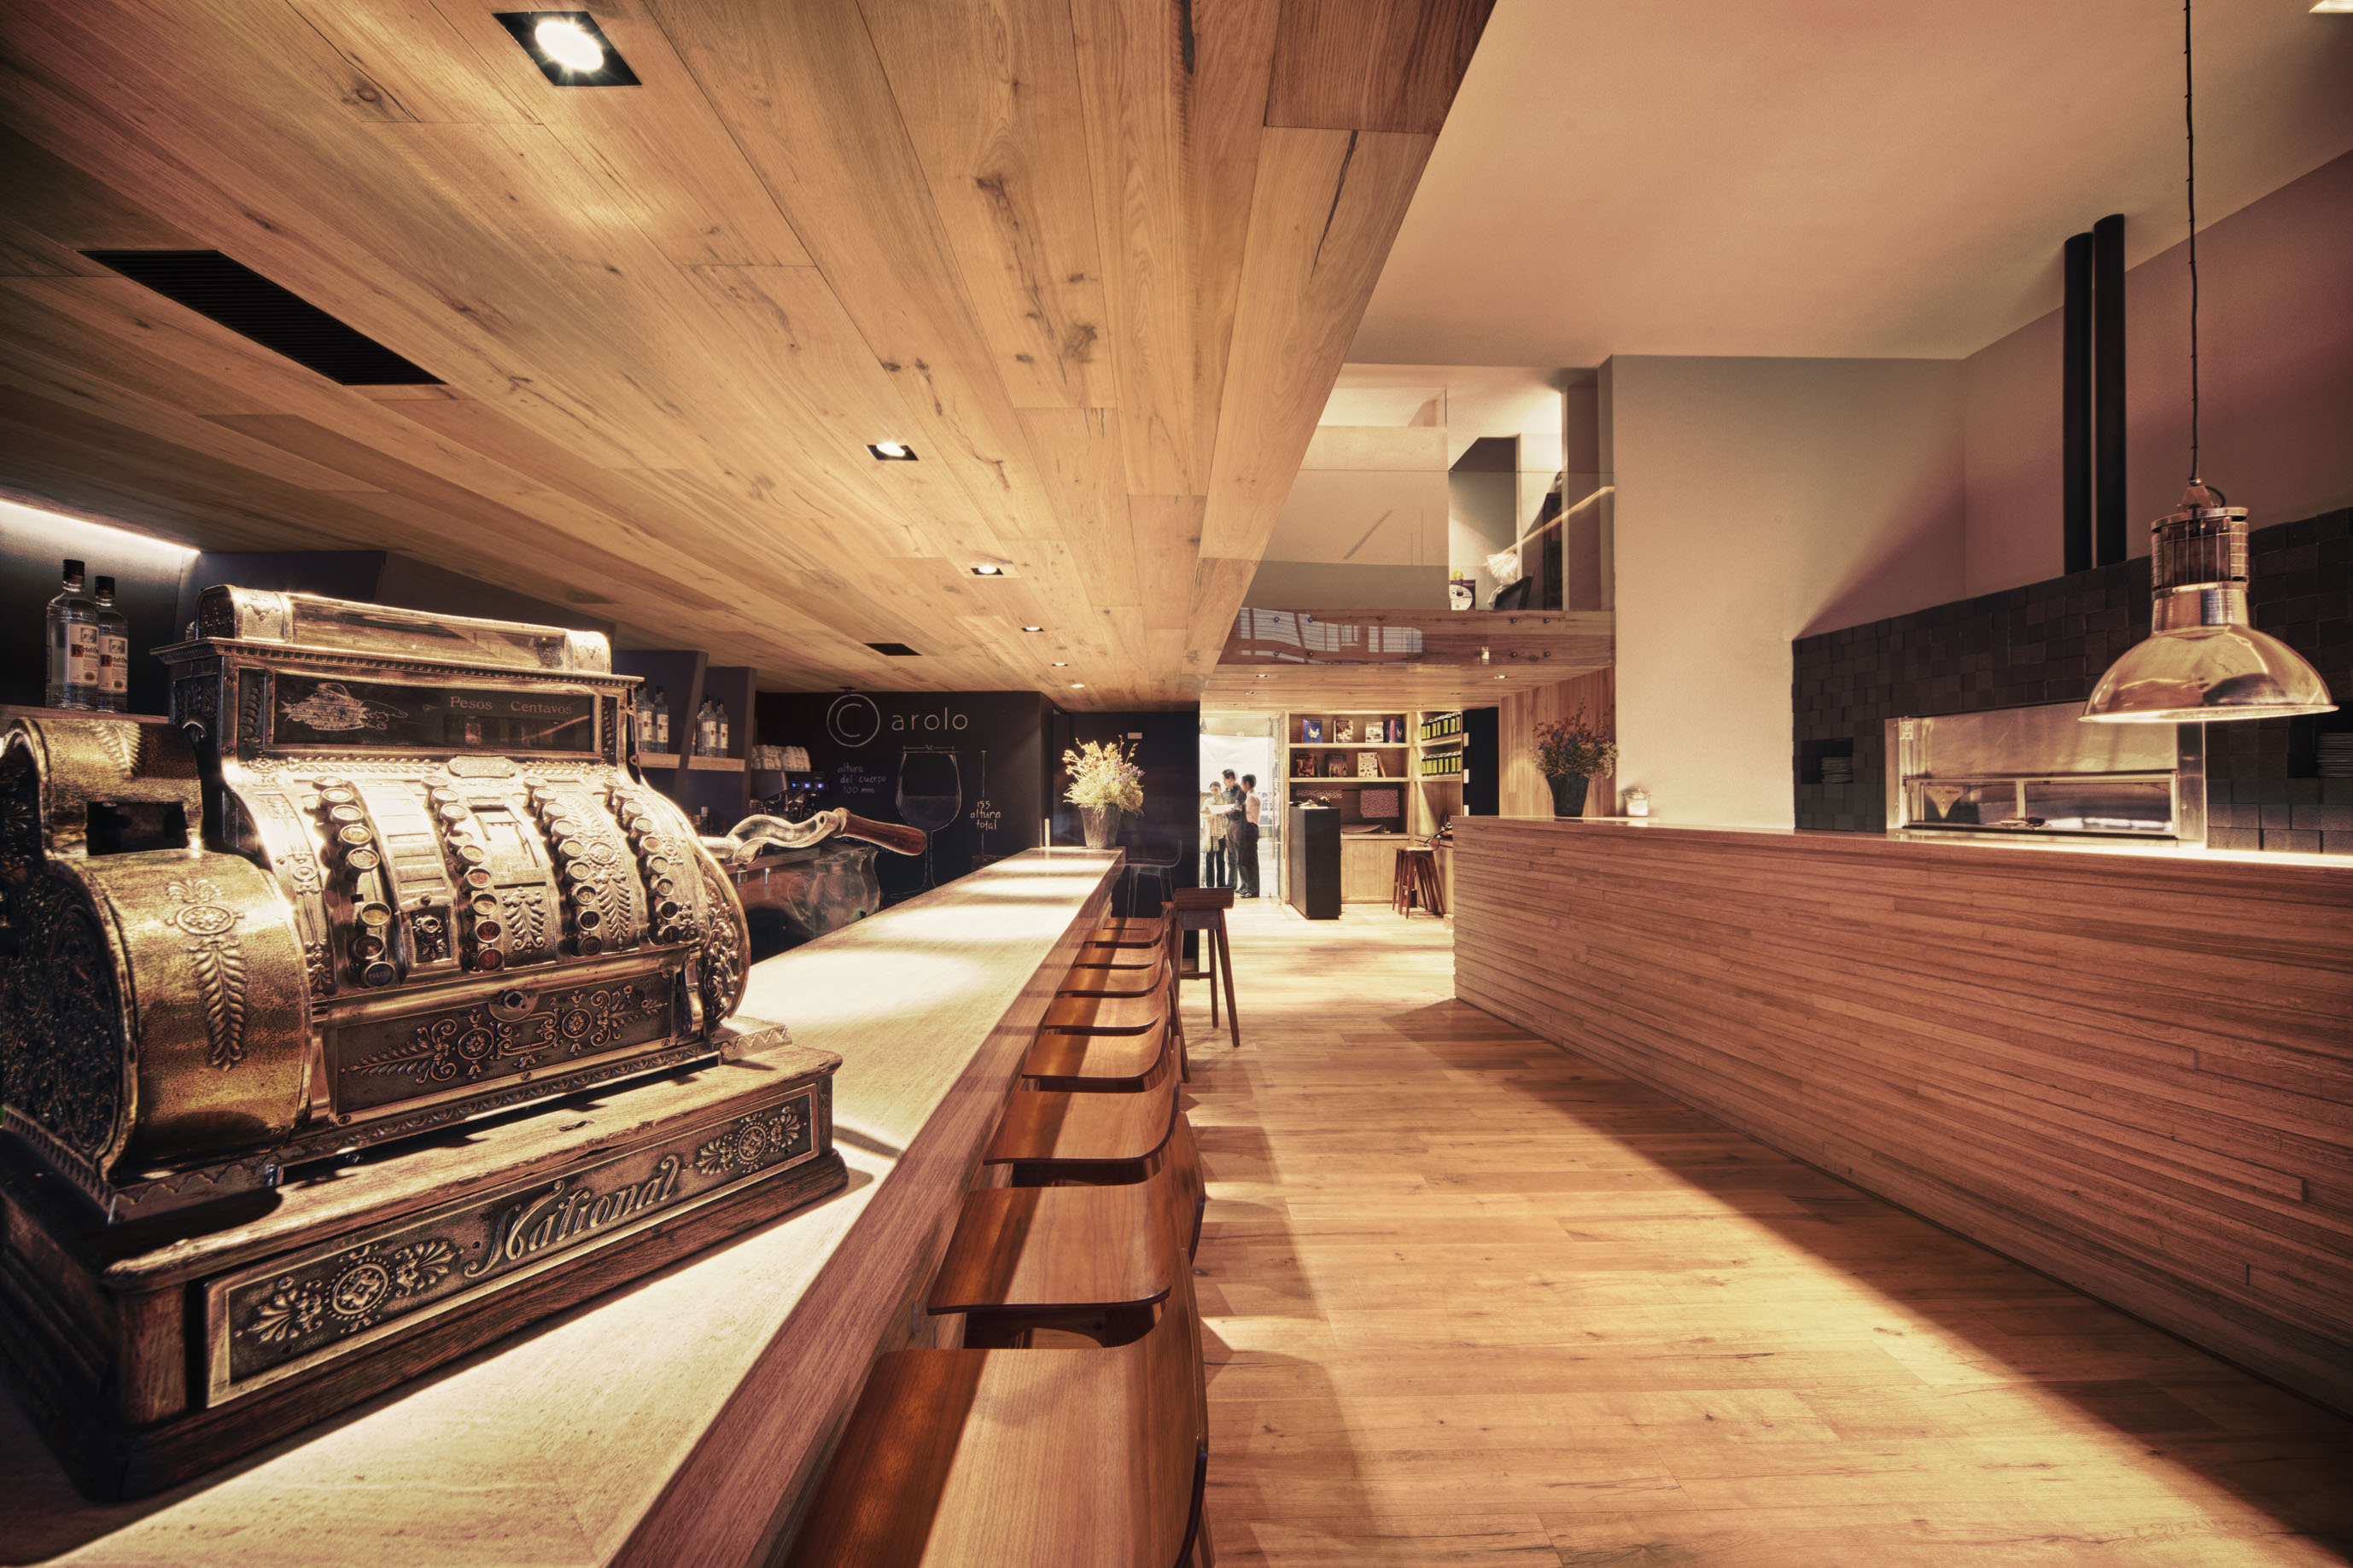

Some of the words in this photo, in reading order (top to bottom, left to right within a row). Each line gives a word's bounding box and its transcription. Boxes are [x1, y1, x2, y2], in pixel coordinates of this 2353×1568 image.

[450, 696, 493, 710] Pesos
[510, 701, 573, 714] Centavos
[837, 761, 864, 773] altura
[840, 774, 853, 784] del
[858, 776, 888, 785] cuerpo
[977, 800, 991, 810] 155
[970, 807, 1002, 819] altura
[976, 819, 997, 831] total
[464, 1154, 679, 1278] National
